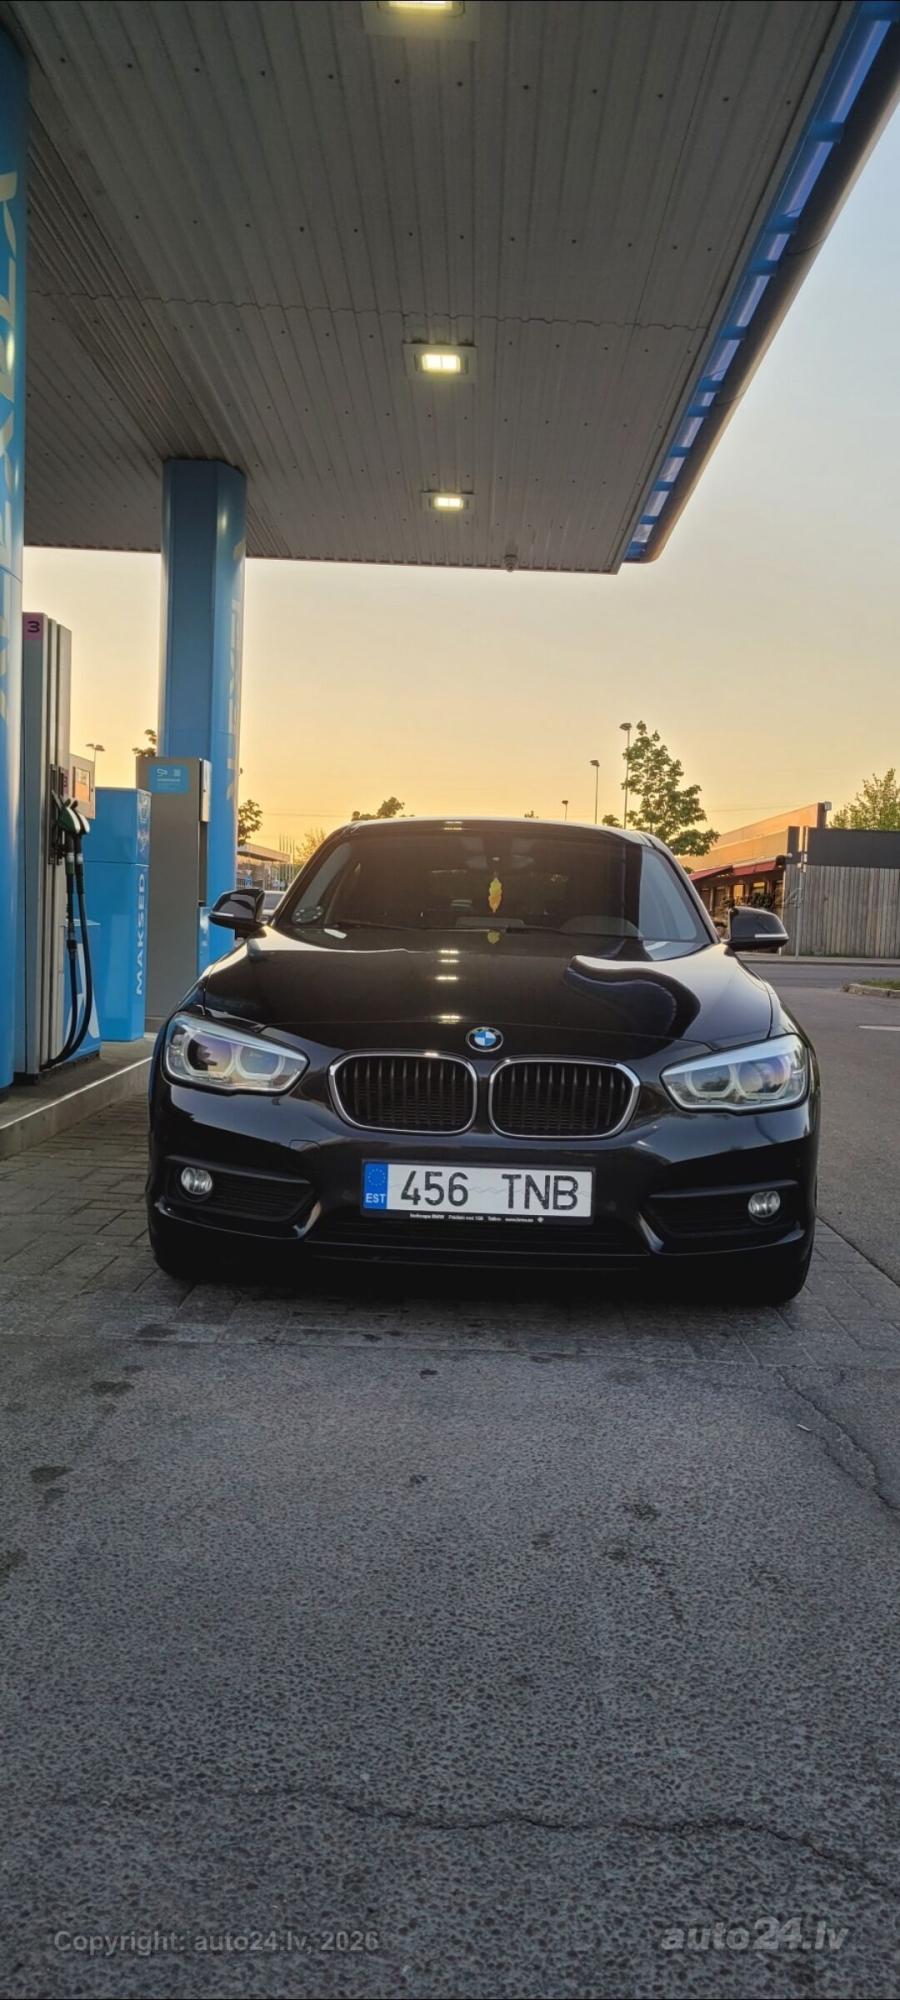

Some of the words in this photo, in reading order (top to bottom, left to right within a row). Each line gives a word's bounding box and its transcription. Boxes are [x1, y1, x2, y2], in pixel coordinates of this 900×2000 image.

[27, 620, 41, 633] 3
[136, 873, 145, 996] MAKSED
[365, 1193, 387, 1205] EST
[400, 1170, 469, 1207] 456
[501, 1173, 579, 1211] TNB
